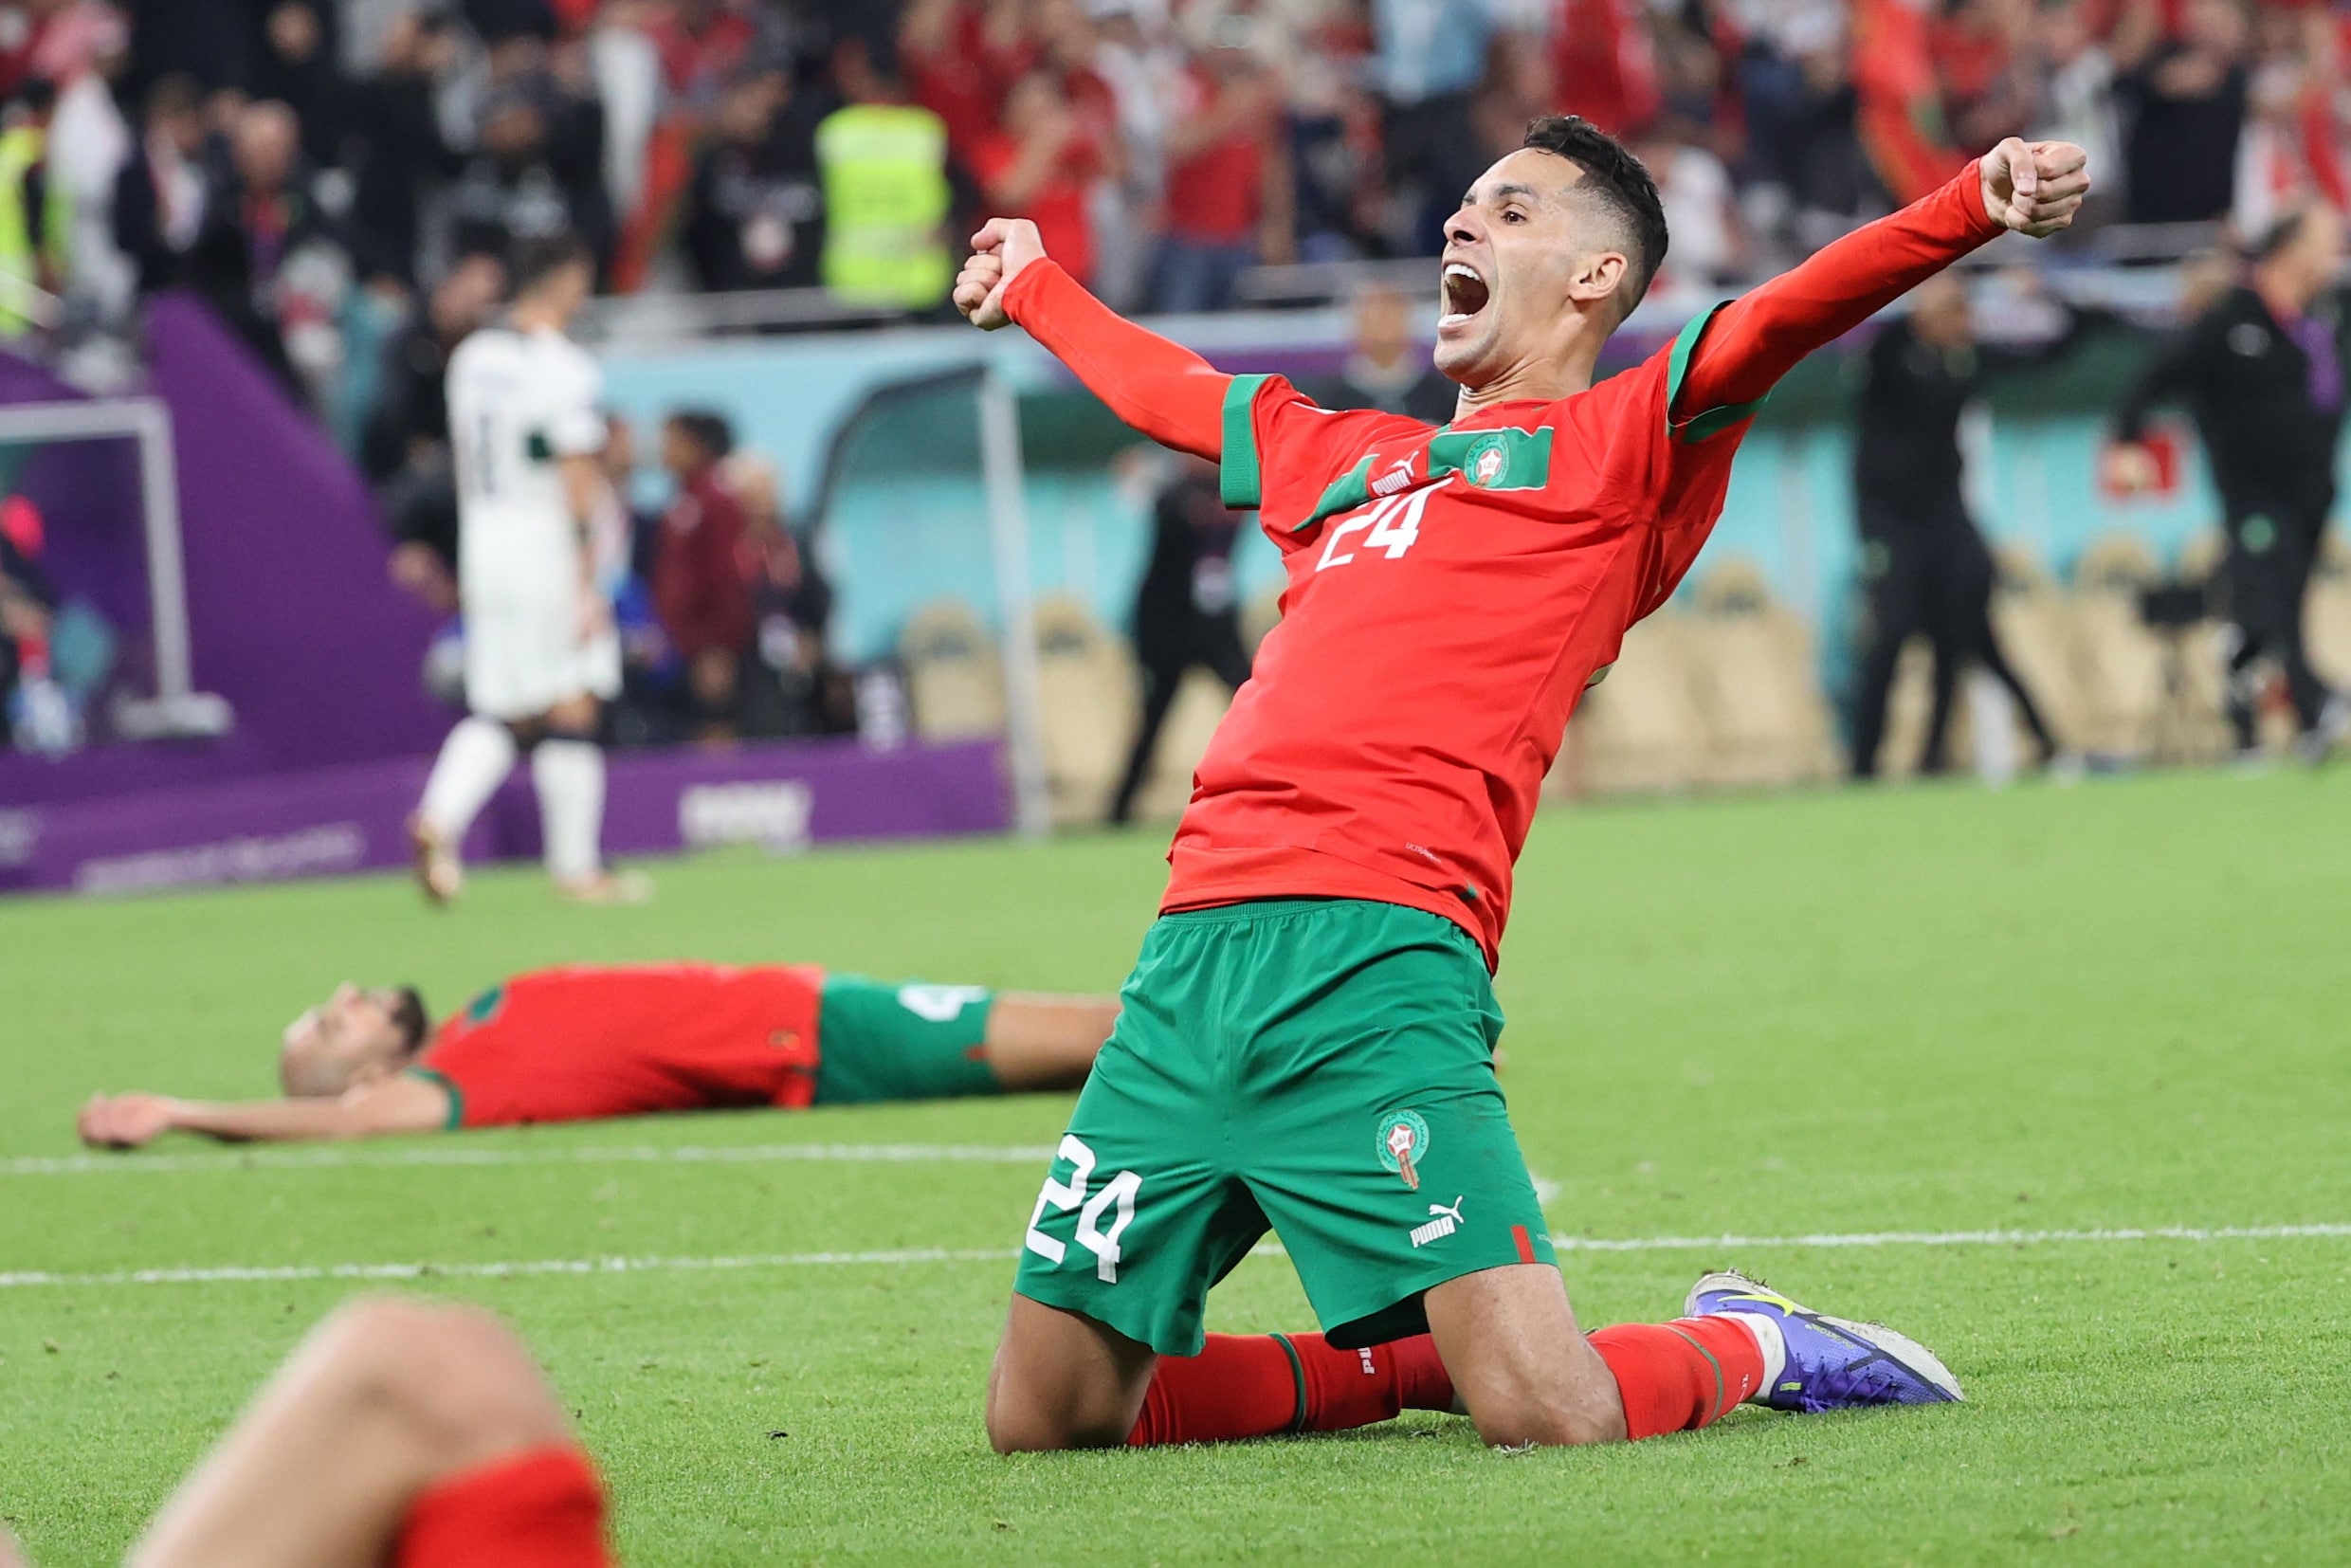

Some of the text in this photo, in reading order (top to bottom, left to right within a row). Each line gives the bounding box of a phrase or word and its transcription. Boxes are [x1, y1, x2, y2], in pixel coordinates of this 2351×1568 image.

[1371, 468, 1412, 497] PUMA
[1315, 477, 1454, 572] 24
[1025, 1134, 1143, 1284] 24
[1409, 1215, 1456, 1249] PUMA
